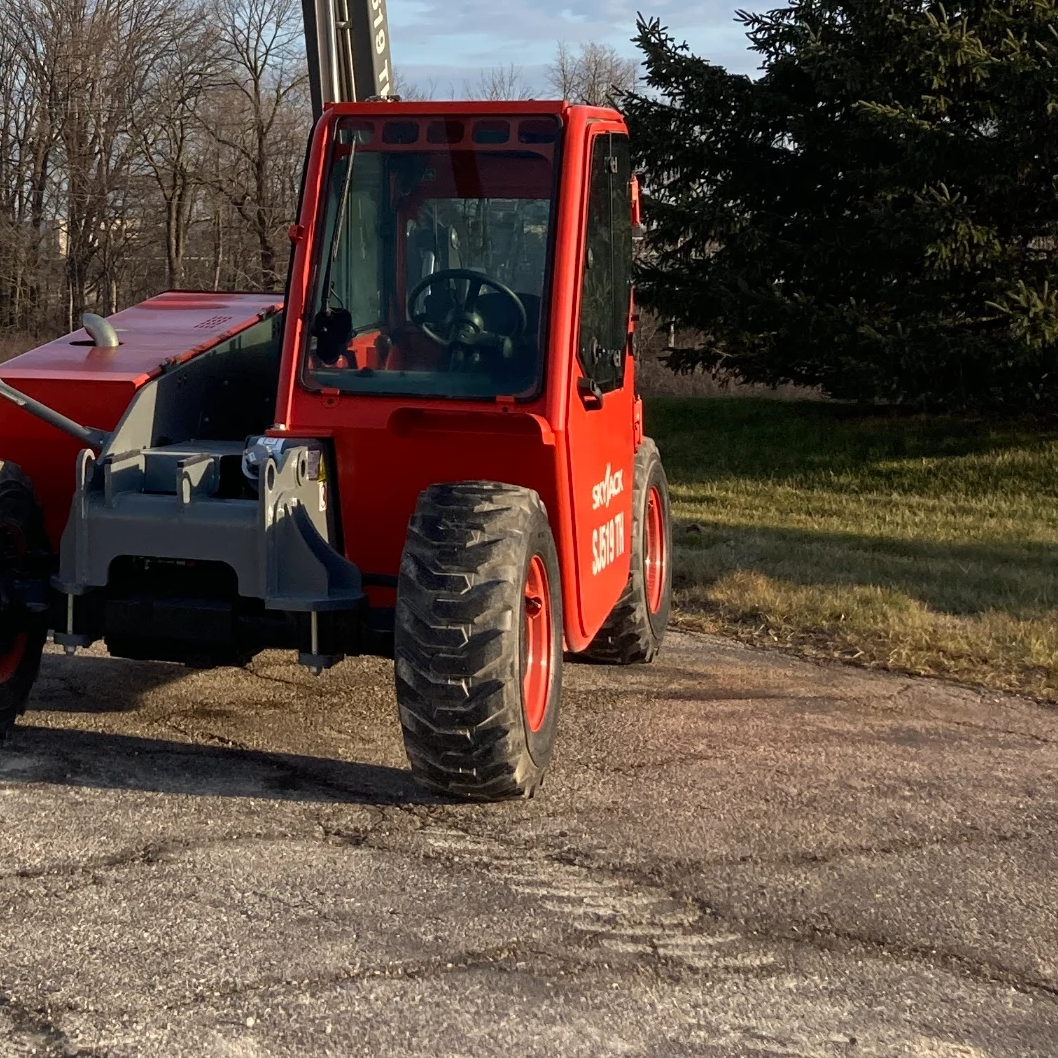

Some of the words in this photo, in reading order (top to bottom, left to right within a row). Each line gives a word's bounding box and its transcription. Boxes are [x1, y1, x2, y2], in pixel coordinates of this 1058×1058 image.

[592, 462, 623, 510] SKYJACK
[592, 518, 614, 575] SJ519
[615, 511, 624, 557] TH
